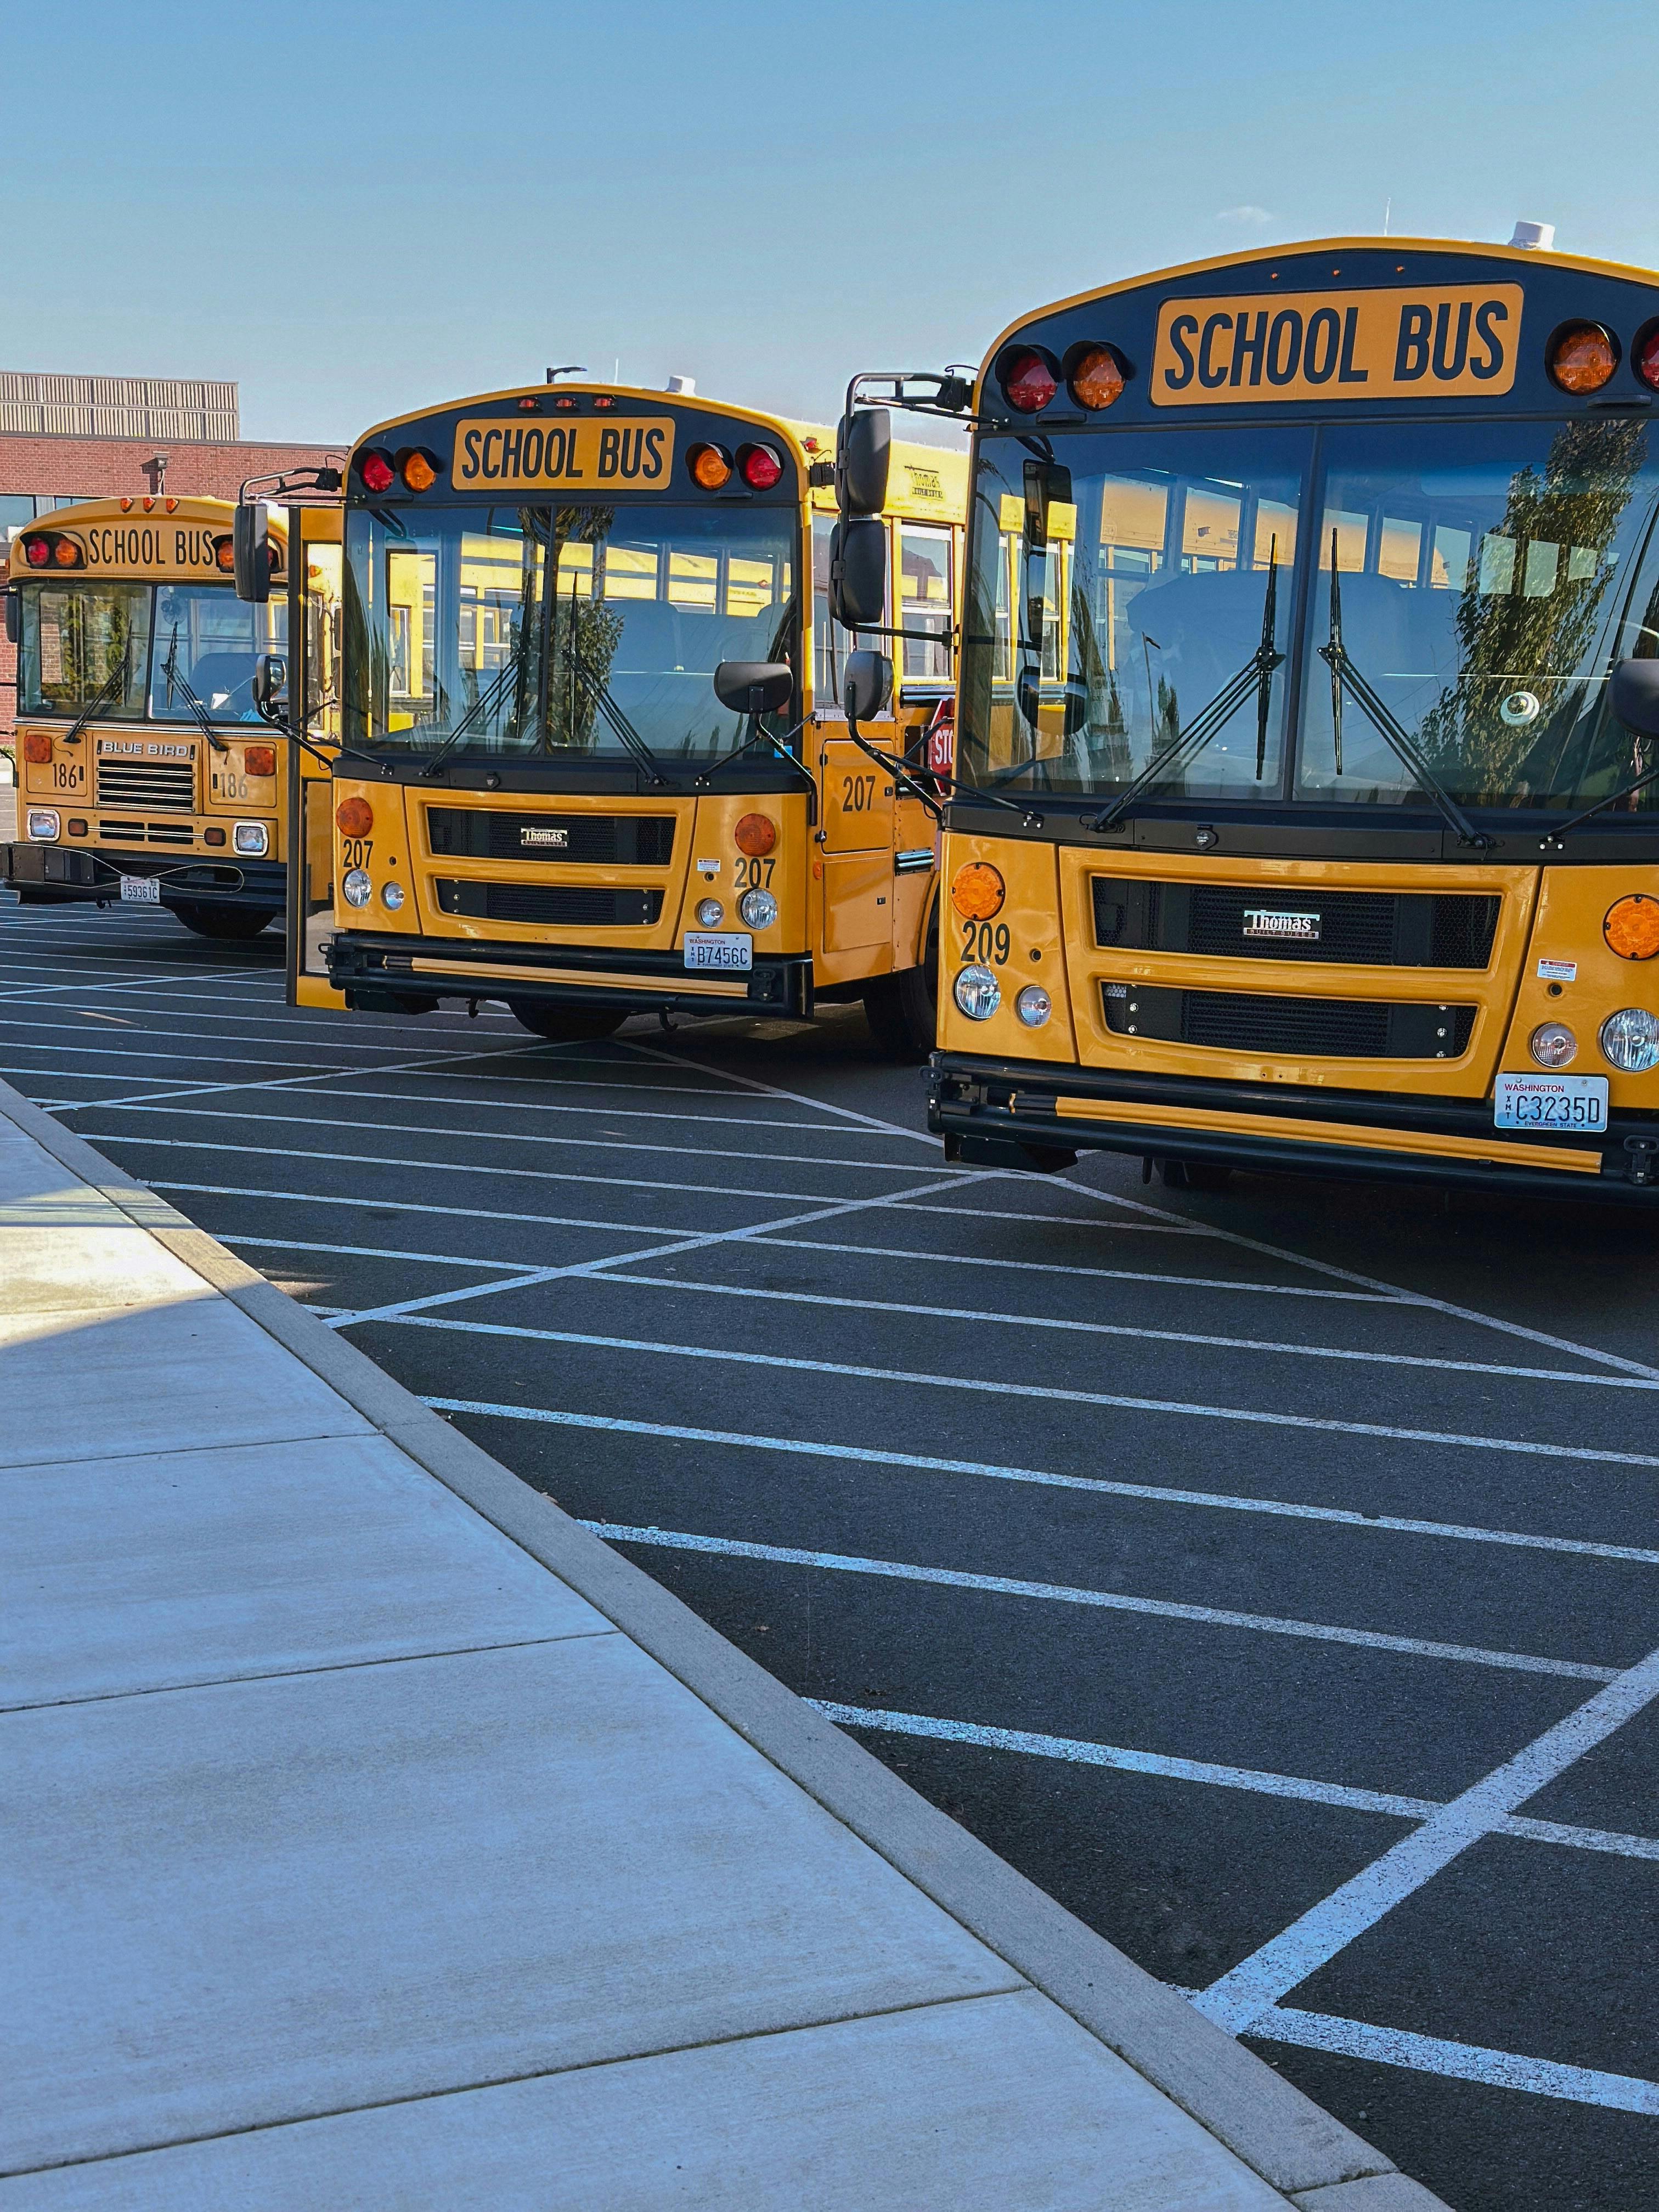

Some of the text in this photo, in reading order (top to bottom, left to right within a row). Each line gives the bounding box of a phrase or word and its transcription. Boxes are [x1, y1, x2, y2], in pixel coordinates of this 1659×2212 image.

[1165, 300, 1508, 390] SCHOOL BUS
[462, 428, 665, 478] SCHOOL BUS
[89, 529, 213, 565] SCHOOL BUS
[103, 742, 188, 757] BLUE BIRD
[935, 730, 953, 764] STO
[53, 763, 76, 788] 186
[221, 772, 247, 799] 186
[843, 775, 876, 812] 207
[521, 828, 567, 842] Thomas
[343, 839, 374, 869] 207
[734, 857, 776, 889] 207
[128, 885, 157, 899] 59361C
[1244, 910, 1320, 931] Thomas
[697, 946, 747, 964] B7456C
[961, 921, 1011, 966] 209
[1505, 1084, 1564, 1093] WASHINGTON
[1516, 1095, 1600, 1123] C3235D
